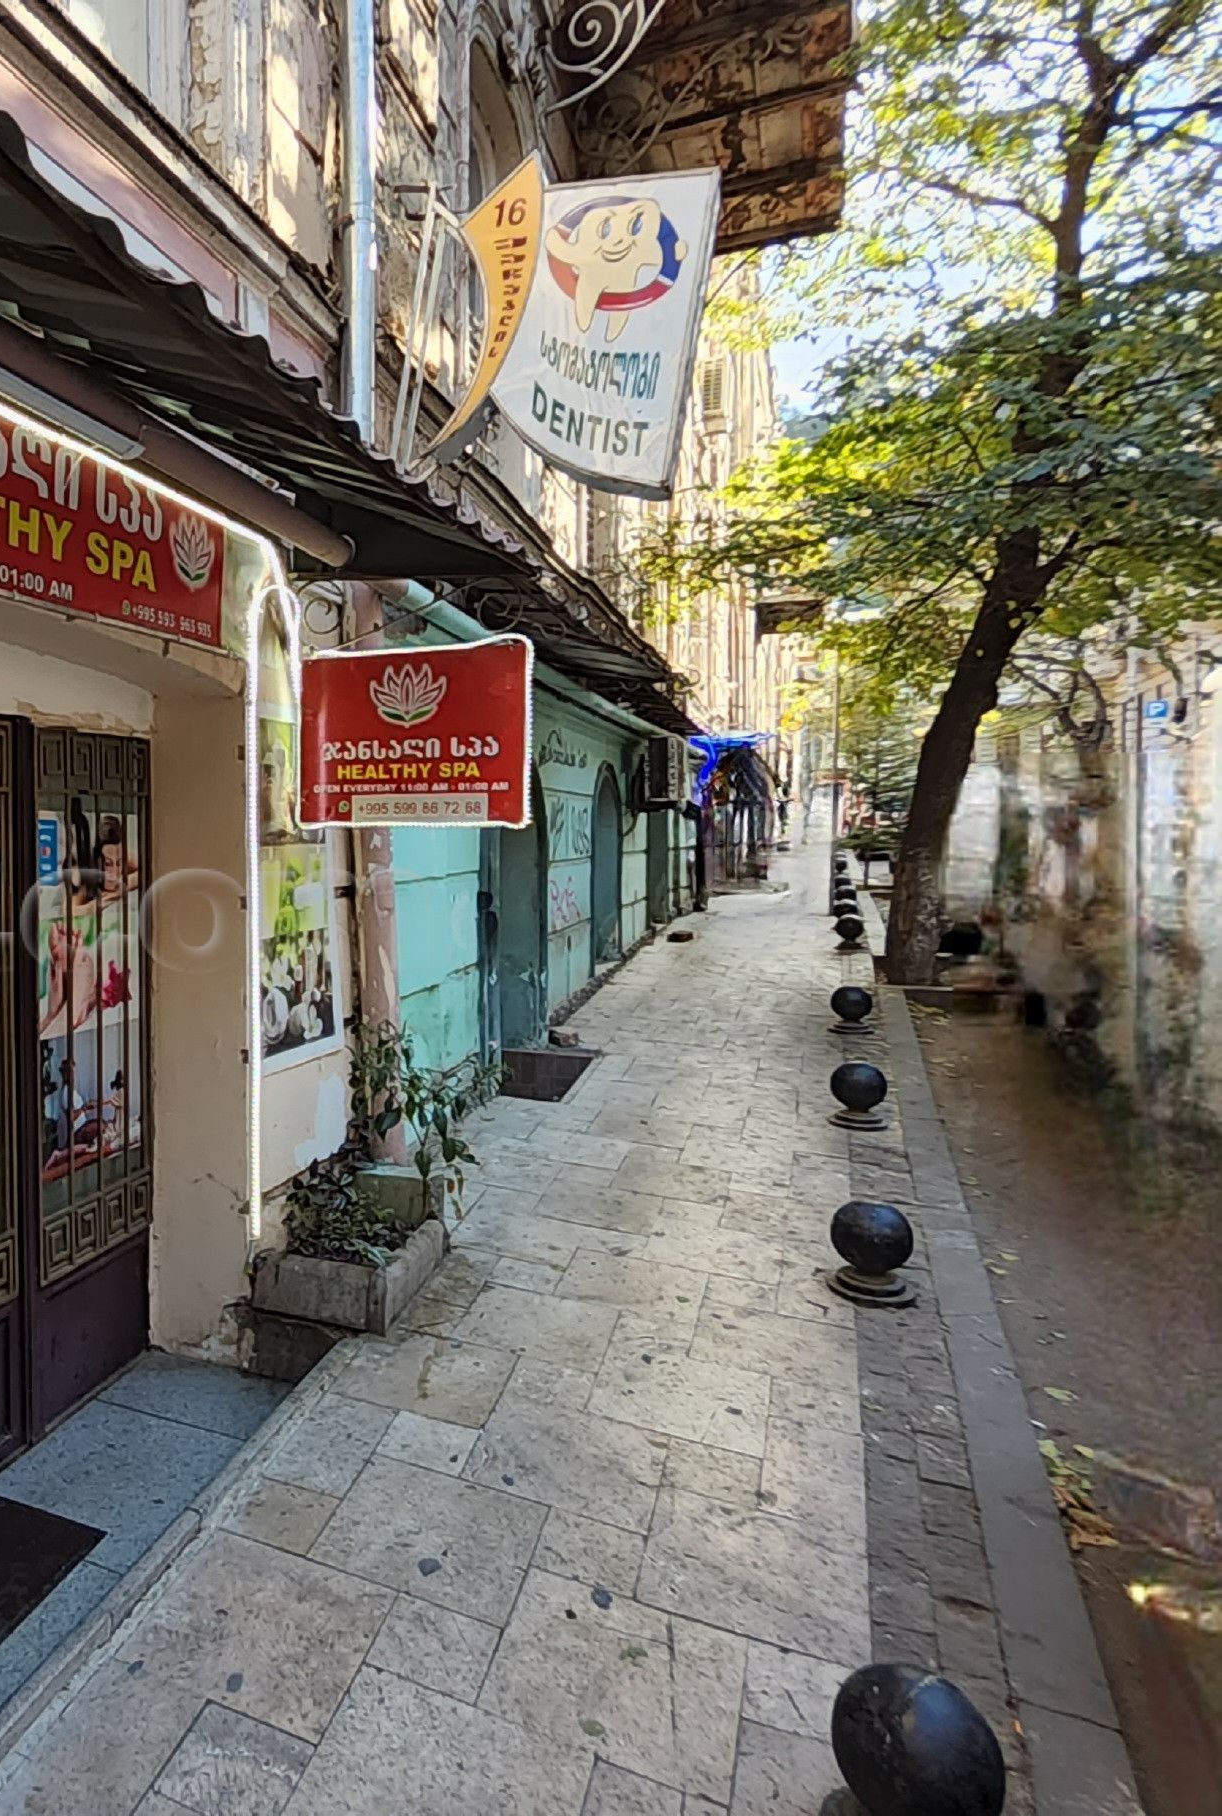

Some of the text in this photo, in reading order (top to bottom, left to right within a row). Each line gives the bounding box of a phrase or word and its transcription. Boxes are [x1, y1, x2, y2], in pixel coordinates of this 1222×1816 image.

[494, 197, 527, 228] 16
[531, 380, 650, 457] DENTIST
[84, 531, 158, 594] SPA
[49, 581, 74, 601] AM
[1149, 703, 1165, 715] P
[320, 735, 500, 762] ჯანსაღი სპა
[337, 761, 481, 780] HEALTHY SPA
[313, 784, 341, 794] OPEN
[343, 783, 398, 793] EVERYDAY
[400, 782, 429, 792] 11:00
[431, 782, 449, 792] AM
[458, 781, 489, 791] 01:00
[491, 781, 510, 791] AM
[359, 802, 389, 815] +995
[444, 801, 460, 814] 72
